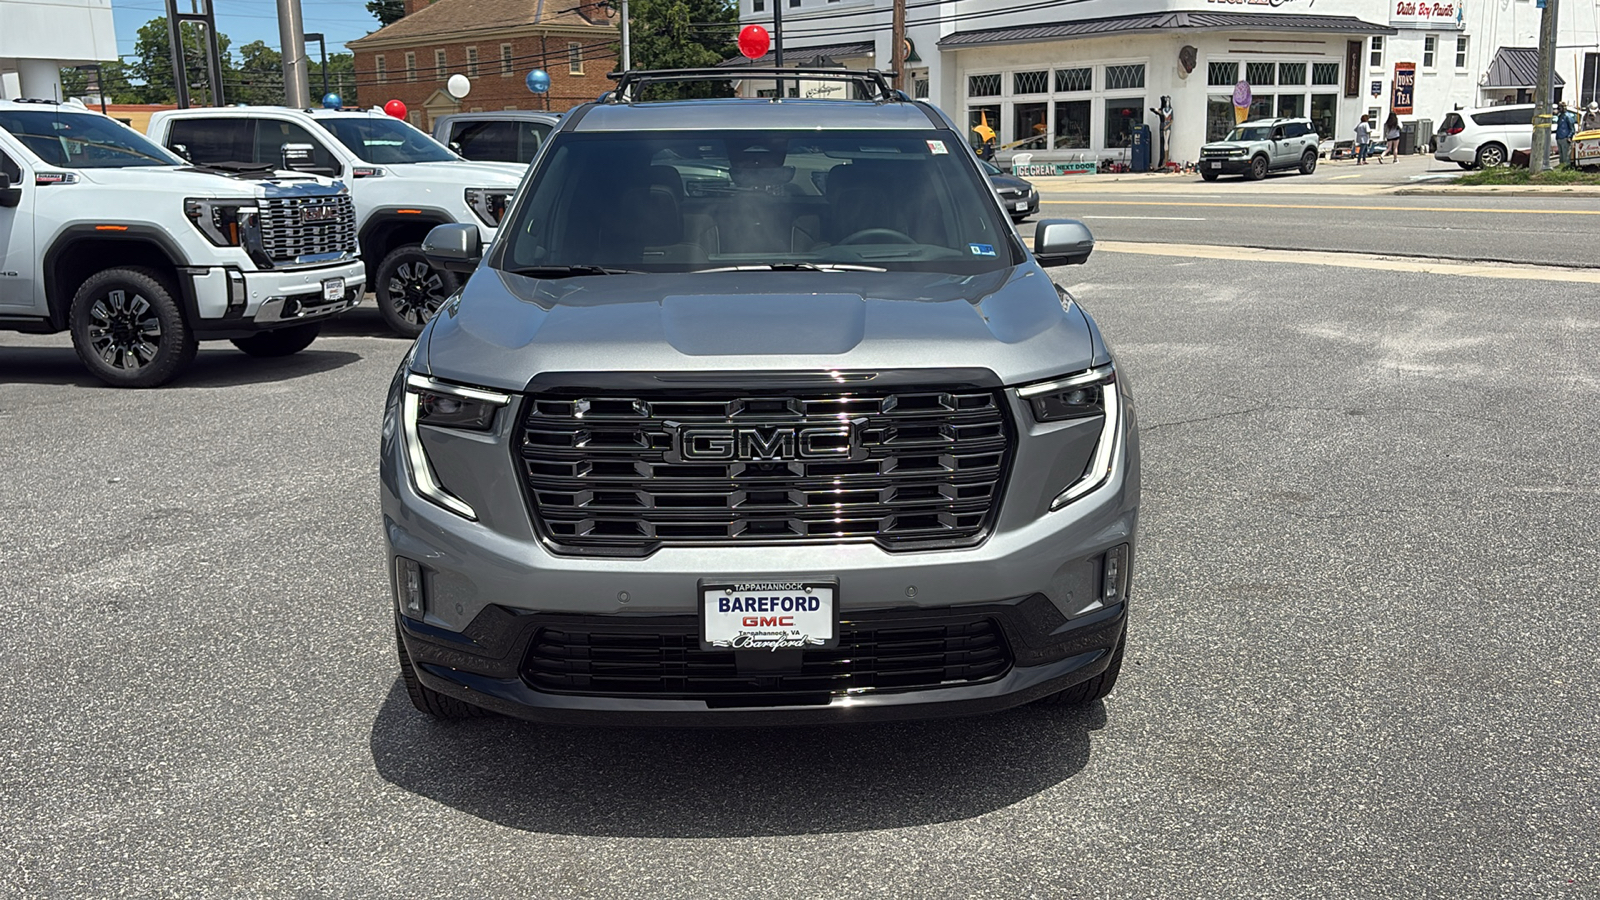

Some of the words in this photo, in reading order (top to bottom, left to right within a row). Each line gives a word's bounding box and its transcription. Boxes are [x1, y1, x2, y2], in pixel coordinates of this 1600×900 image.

[1396, 1, 1416, 16] Dutch
[1418, 2, 1432, 19] Boy
[1432, 2, 1454, 17] Paints
[1397, 92, 1411, 105] TEA
[1016, 166, 1029, 176] ICE
[1030, 165, 1057, 176] CREAM
[683, 427, 851, 460] GMC
[734, 583, 804, 592] TAPPAHANNOCK
[718, 596, 820, 613] BAREFORD
[742, 616, 795, 627] GMC
[732, 634, 809, 652] Bareford
